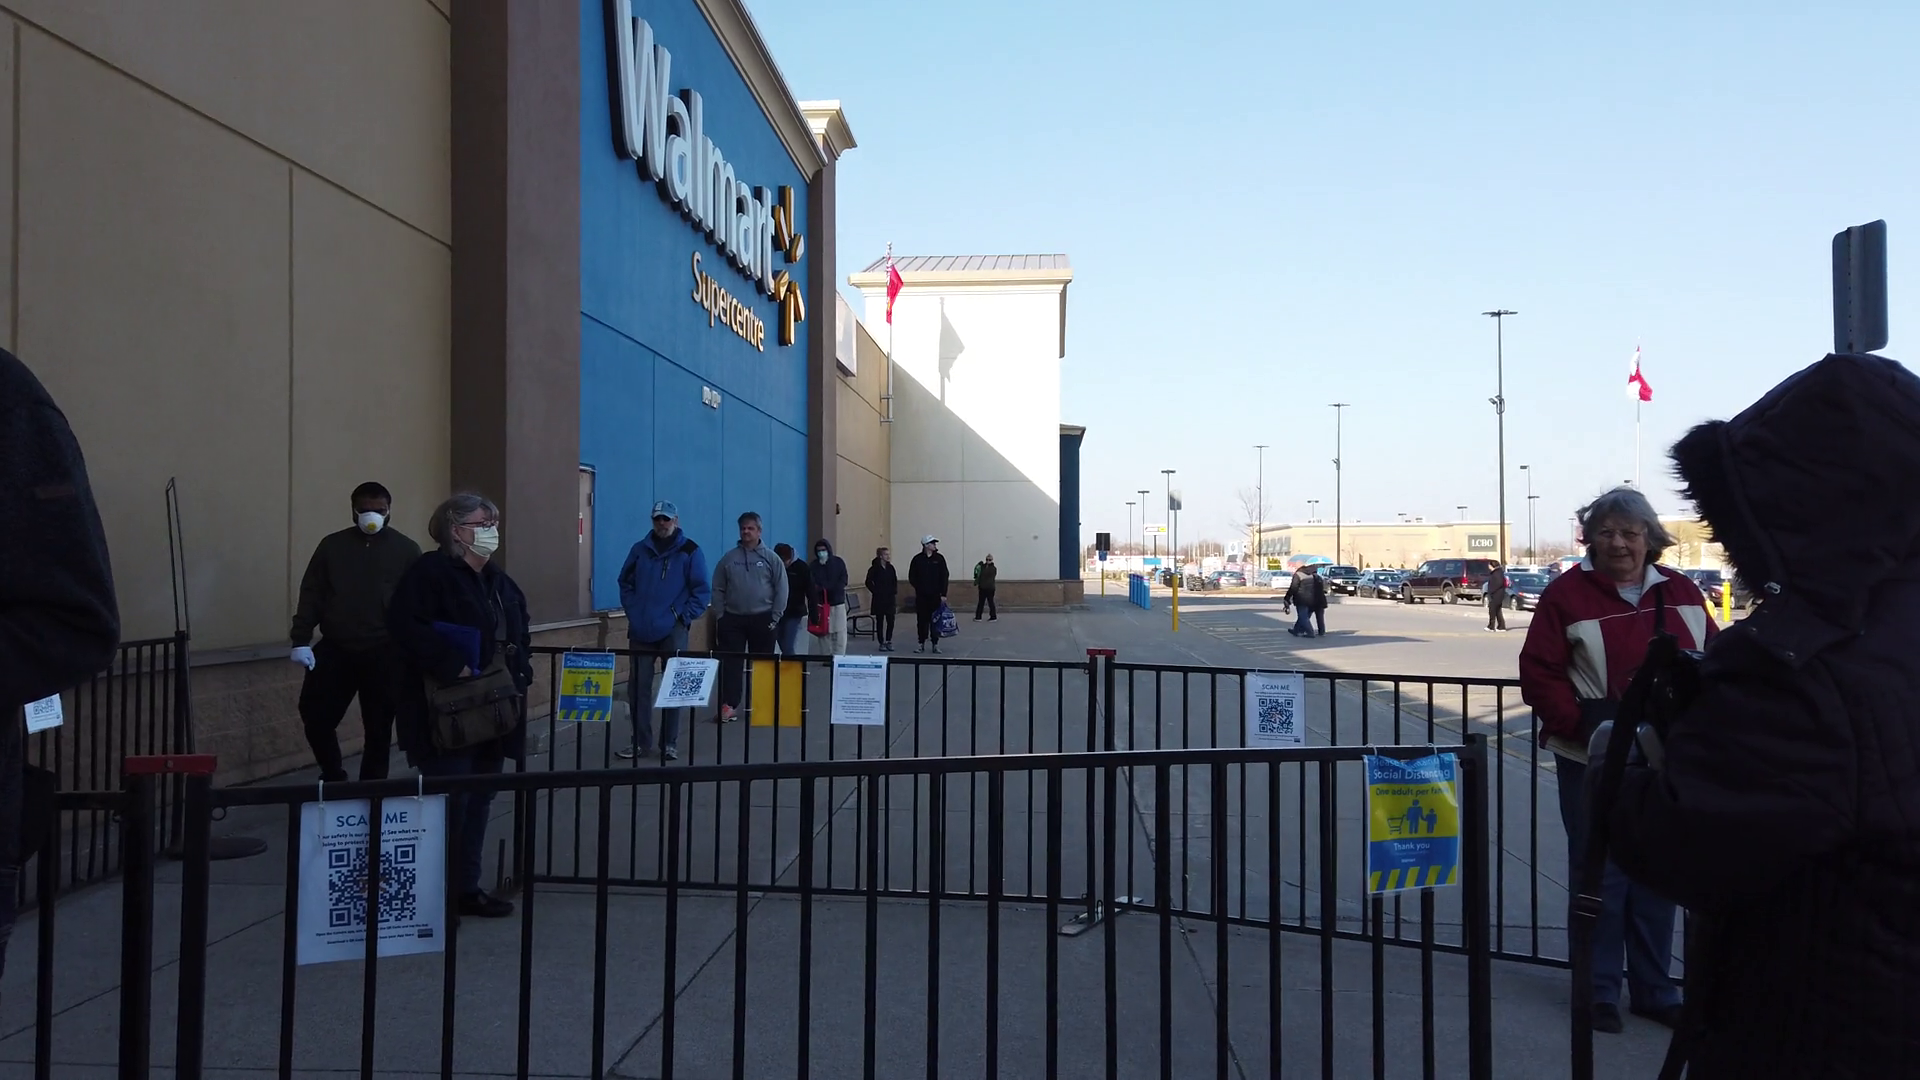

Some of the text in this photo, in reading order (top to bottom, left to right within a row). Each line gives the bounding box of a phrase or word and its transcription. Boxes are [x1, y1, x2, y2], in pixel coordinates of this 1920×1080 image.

[606, 0, 775, 295] Walmart
[692, 251, 764, 352] Supercentre
[1471, 538, 1494, 547] LCBO
[1373, 768, 1450, 780] Social Distancng
[1376, 788, 1389, 796] One
[1391, 787, 1414, 796] adult
[1415, 788, 1430, 798] per
[336, 811, 408, 828] SCA ME
[1393, 841, 1430, 851] Thank you
